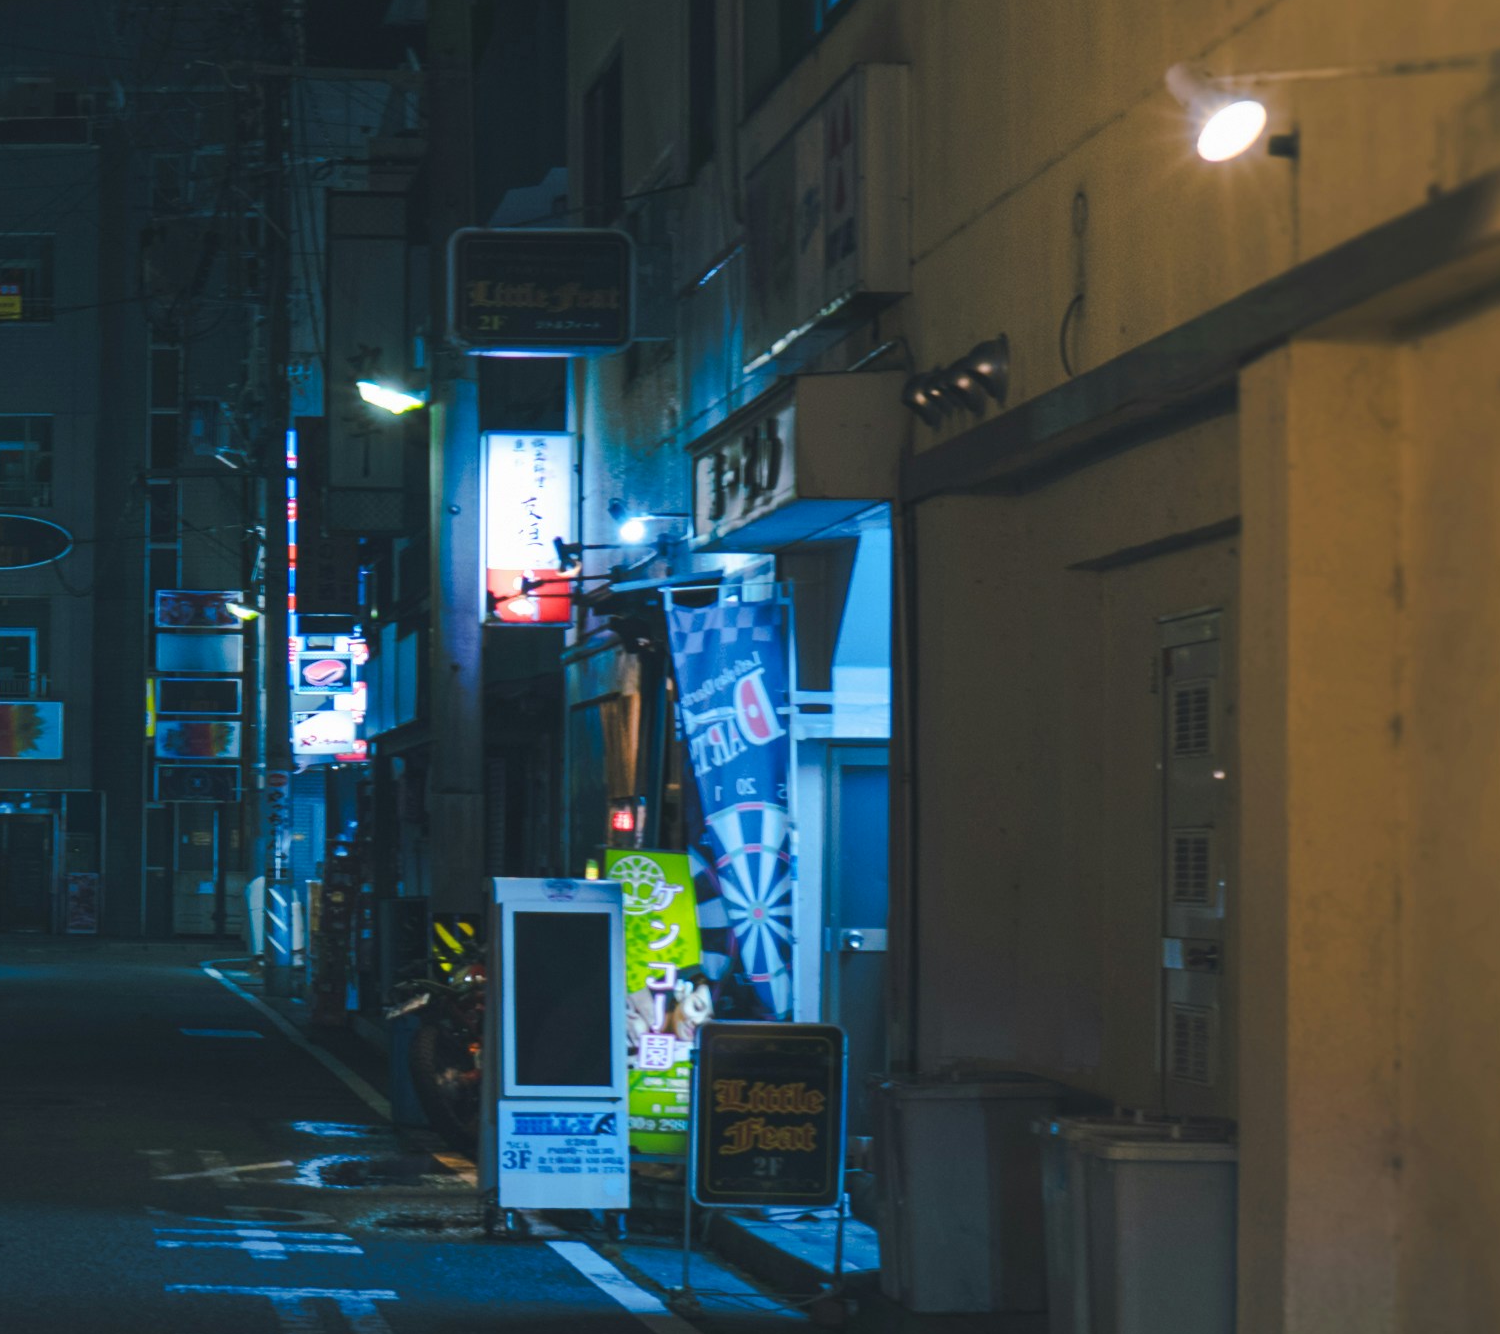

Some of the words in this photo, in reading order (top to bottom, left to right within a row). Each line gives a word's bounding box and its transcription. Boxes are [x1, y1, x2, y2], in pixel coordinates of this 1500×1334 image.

[467, 279, 549, 308] Little
[546, 281, 620, 313] Feat
[477, 314, 508, 331] 2F
[638, 878, 684, 1071] ケンコー園
[713, 1078, 825, 1114] Little
[718, 1117, 817, 1155] Feat
[503, 1149, 533, 1170] 3F
[752, 1156, 784, 1177] 2F
